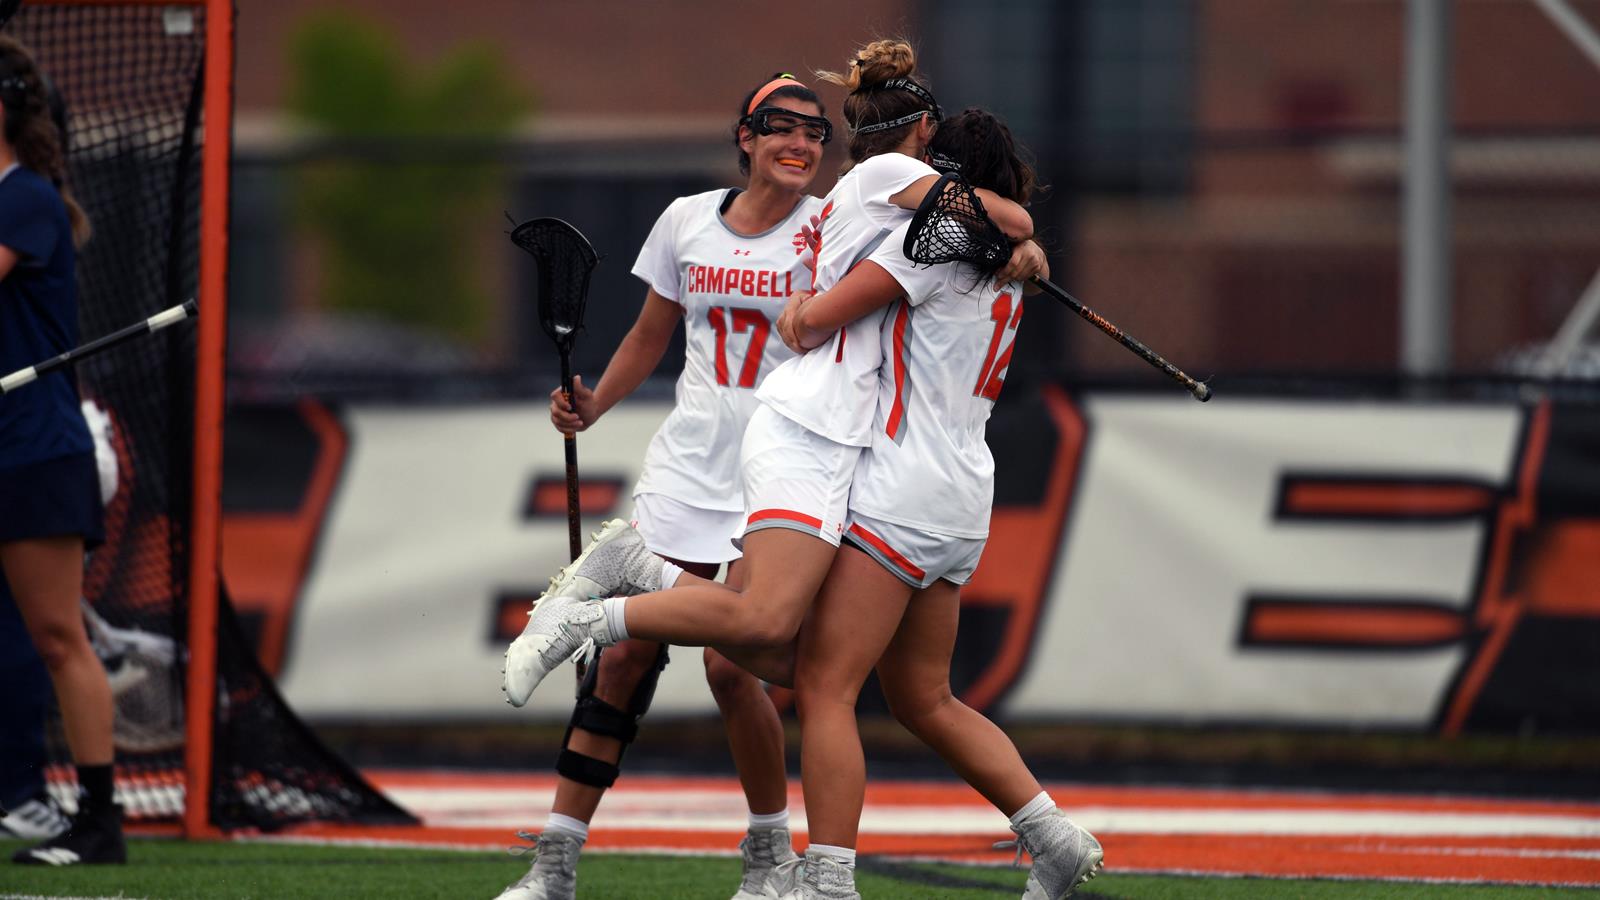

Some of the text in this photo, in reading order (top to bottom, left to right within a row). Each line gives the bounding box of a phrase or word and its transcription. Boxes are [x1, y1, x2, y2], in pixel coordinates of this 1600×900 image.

[688, 265, 792, 297] CAMPBELL
[707, 306, 771, 389] 17
[973, 291, 1024, 401] 12
